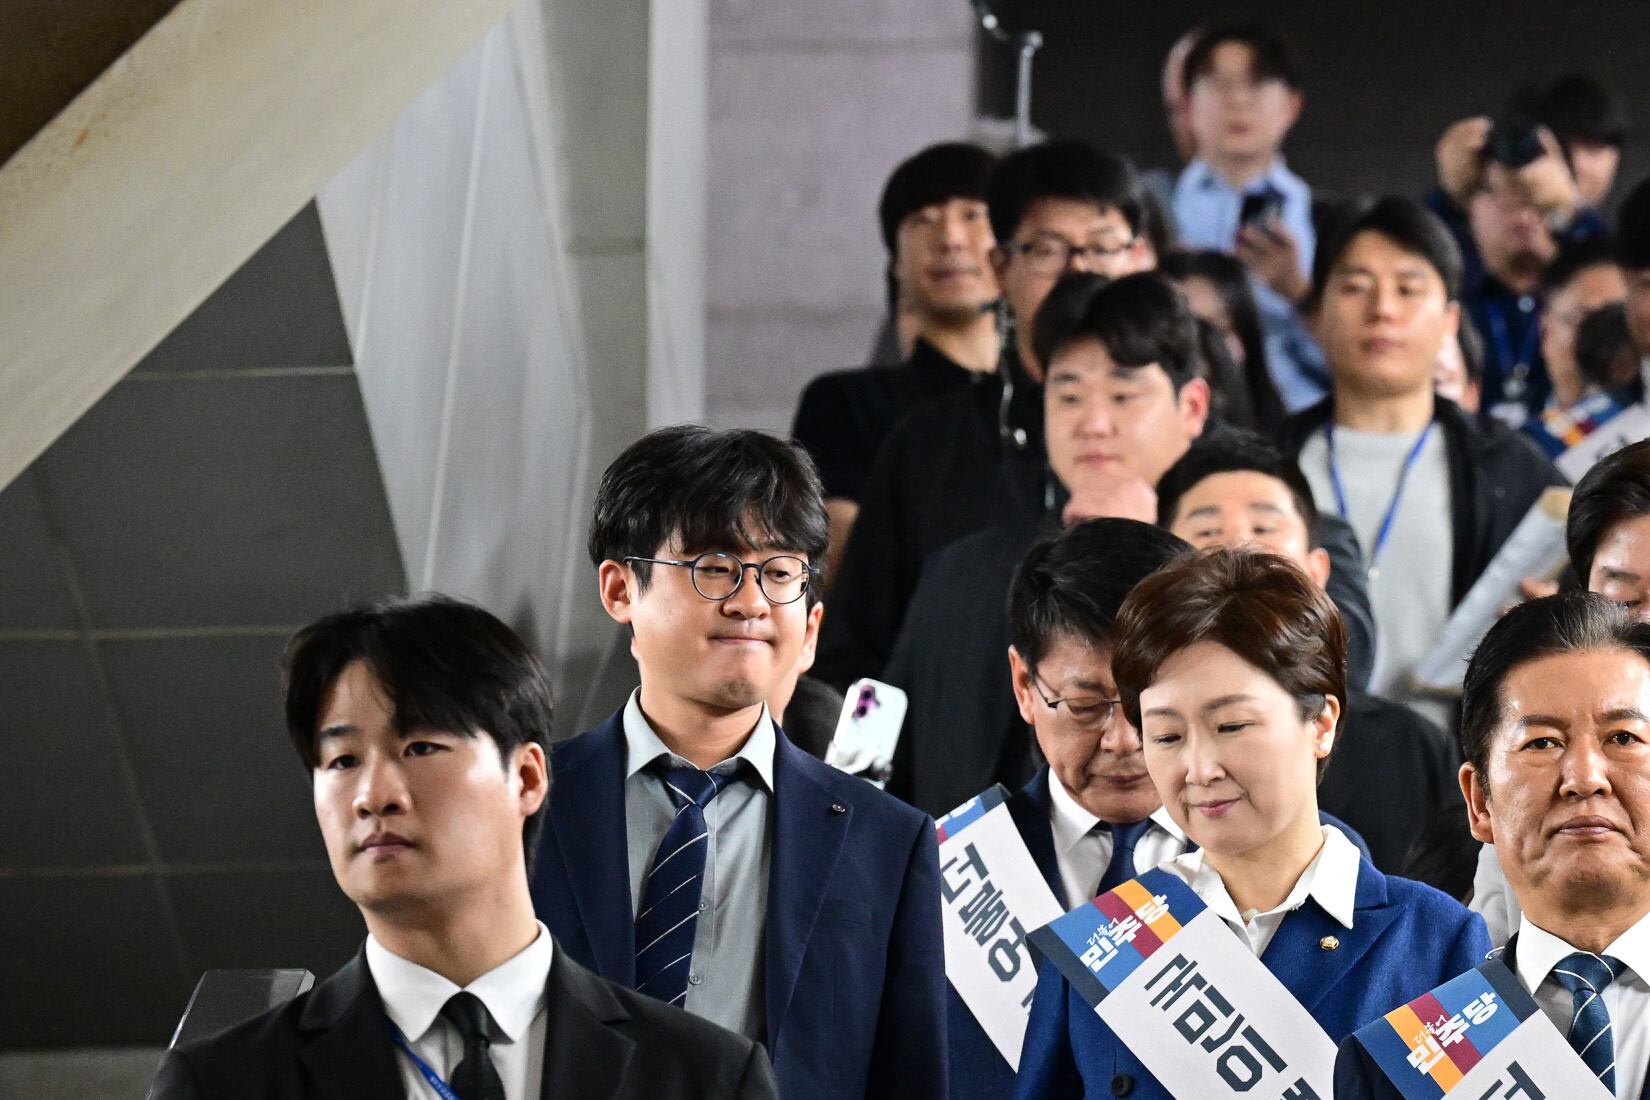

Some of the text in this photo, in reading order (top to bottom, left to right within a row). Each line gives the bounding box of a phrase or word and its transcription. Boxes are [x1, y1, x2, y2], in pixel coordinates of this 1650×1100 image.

[941, 842, 1028, 982] 더불어
[1079, 894, 1169, 973] 민주당
[1086, 917, 1119, 946] 더불어
[1143, 952, 1288, 1092] 국민이
[1406, 991, 1498, 1076] 민주당
[1413, 1015, 1447, 1044] 더불어
